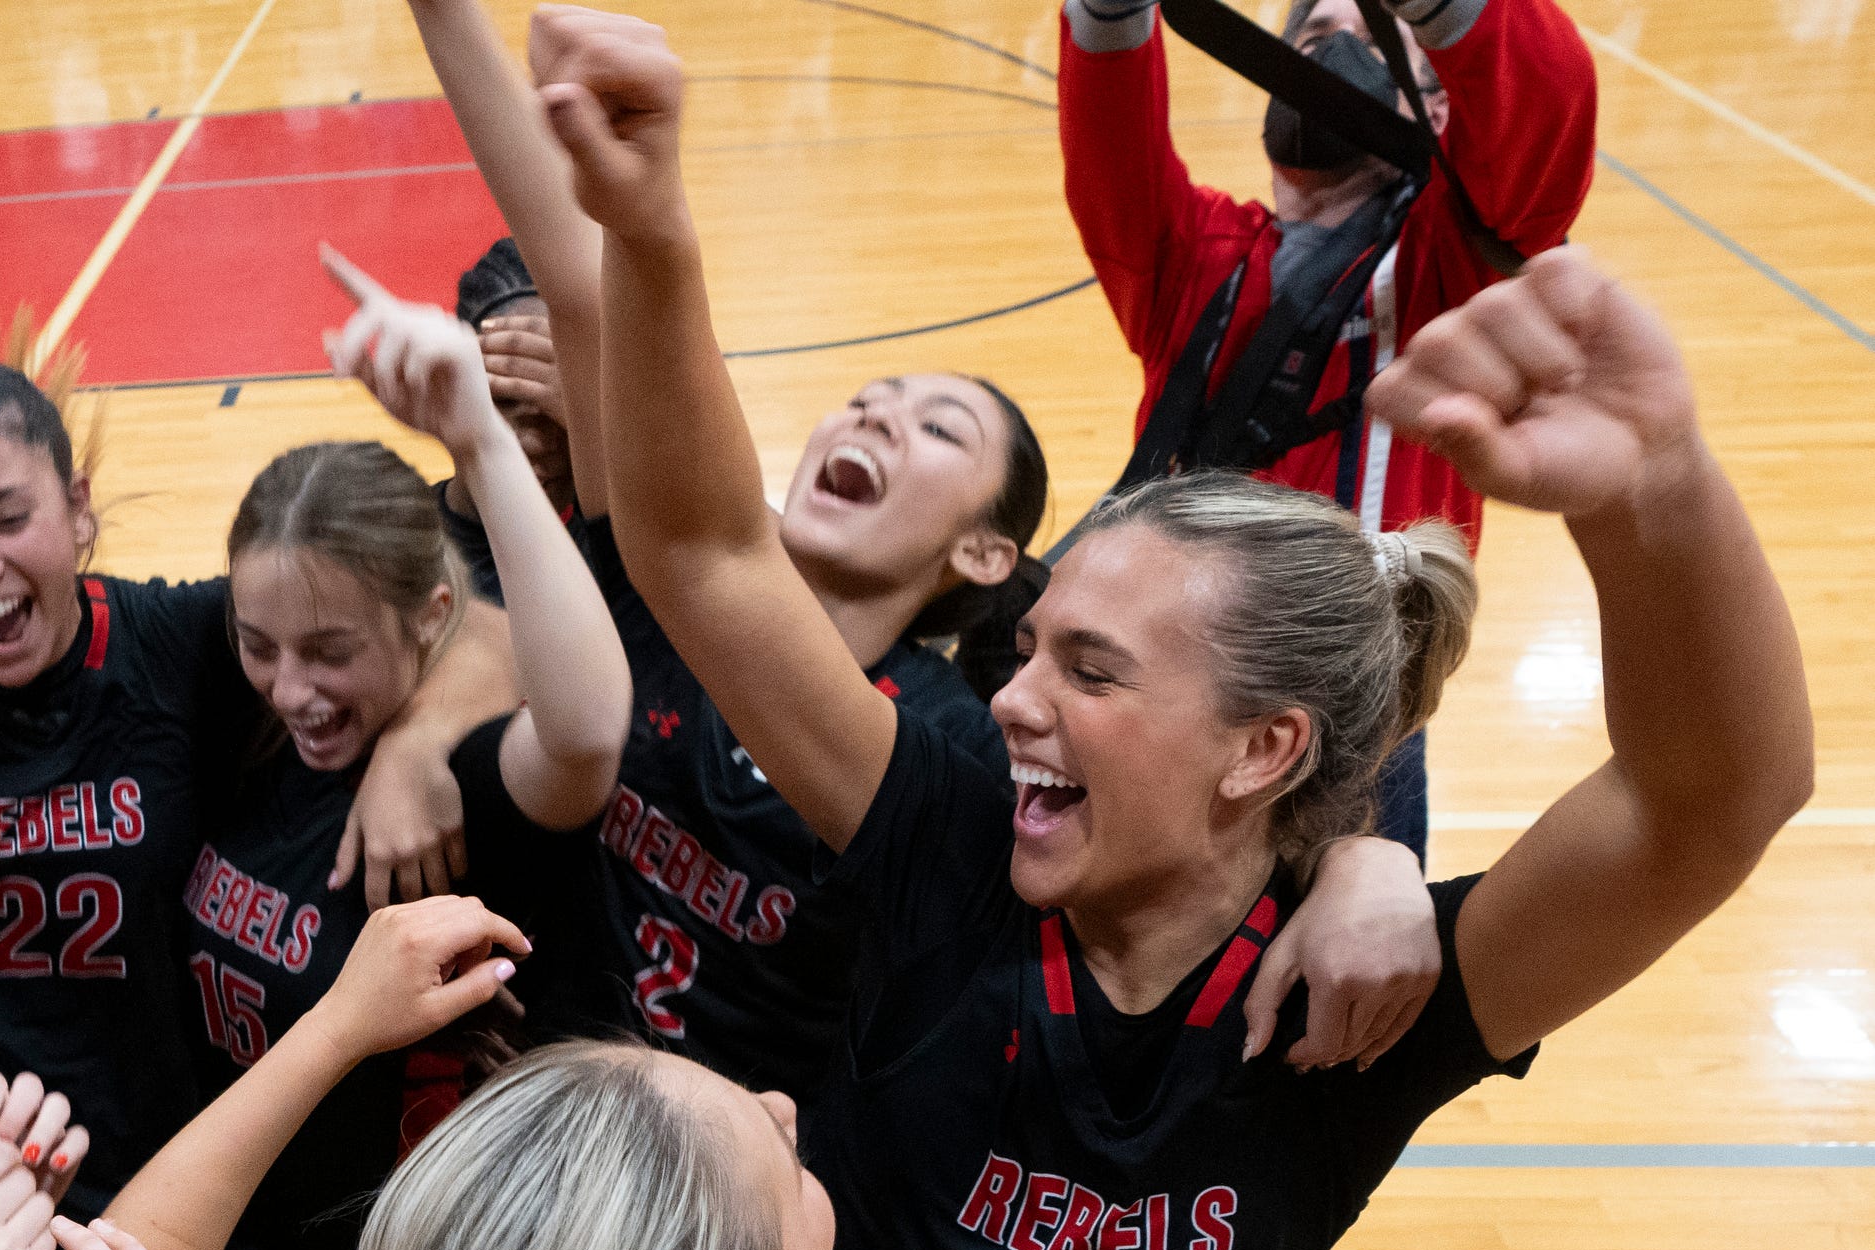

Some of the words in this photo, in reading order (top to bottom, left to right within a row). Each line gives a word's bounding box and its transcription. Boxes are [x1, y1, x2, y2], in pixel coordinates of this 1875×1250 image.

[183, 842, 322, 975] REBELS
[599, 783, 797, 945] REBELS
[188, 950, 267, 1070] 15
[633, 913, 700, 1040] 2
